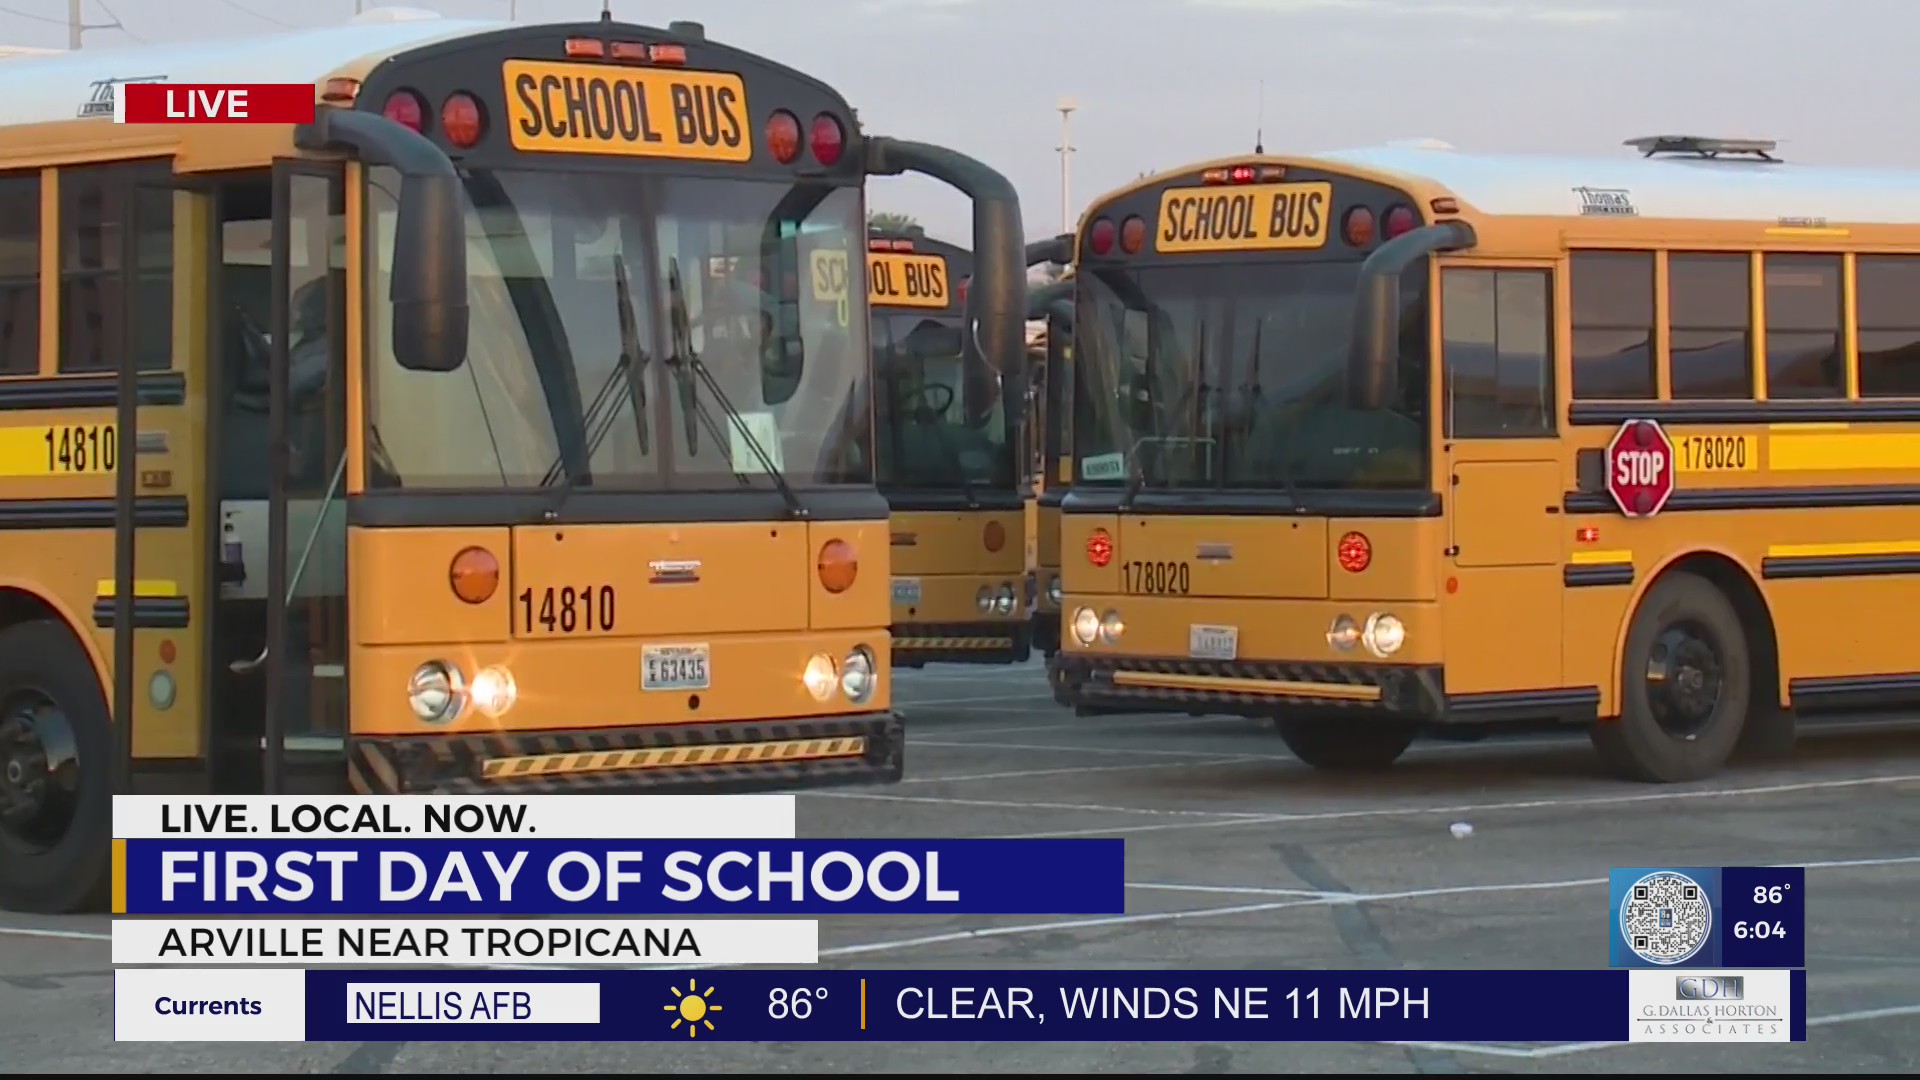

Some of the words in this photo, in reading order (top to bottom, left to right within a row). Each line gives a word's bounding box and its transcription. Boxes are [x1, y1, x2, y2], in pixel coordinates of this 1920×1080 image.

[516, 73, 662, 142] SCHOOL
[671, 83, 741, 148] BUS
[1164, 195, 1257, 241] SCHOOL
[1269, 192, 1322, 238] BUS
[905, 262, 943, 297] BUS
[45, 425, 115, 472] 14810
[1683, 437, 1745, 469] 178020
[1617, 451, 1664, 486] STOP
[1122, 561, 1190, 594] 178020
[520, 585, 614, 633] 14810
[661, 659, 704, 681] 63435
